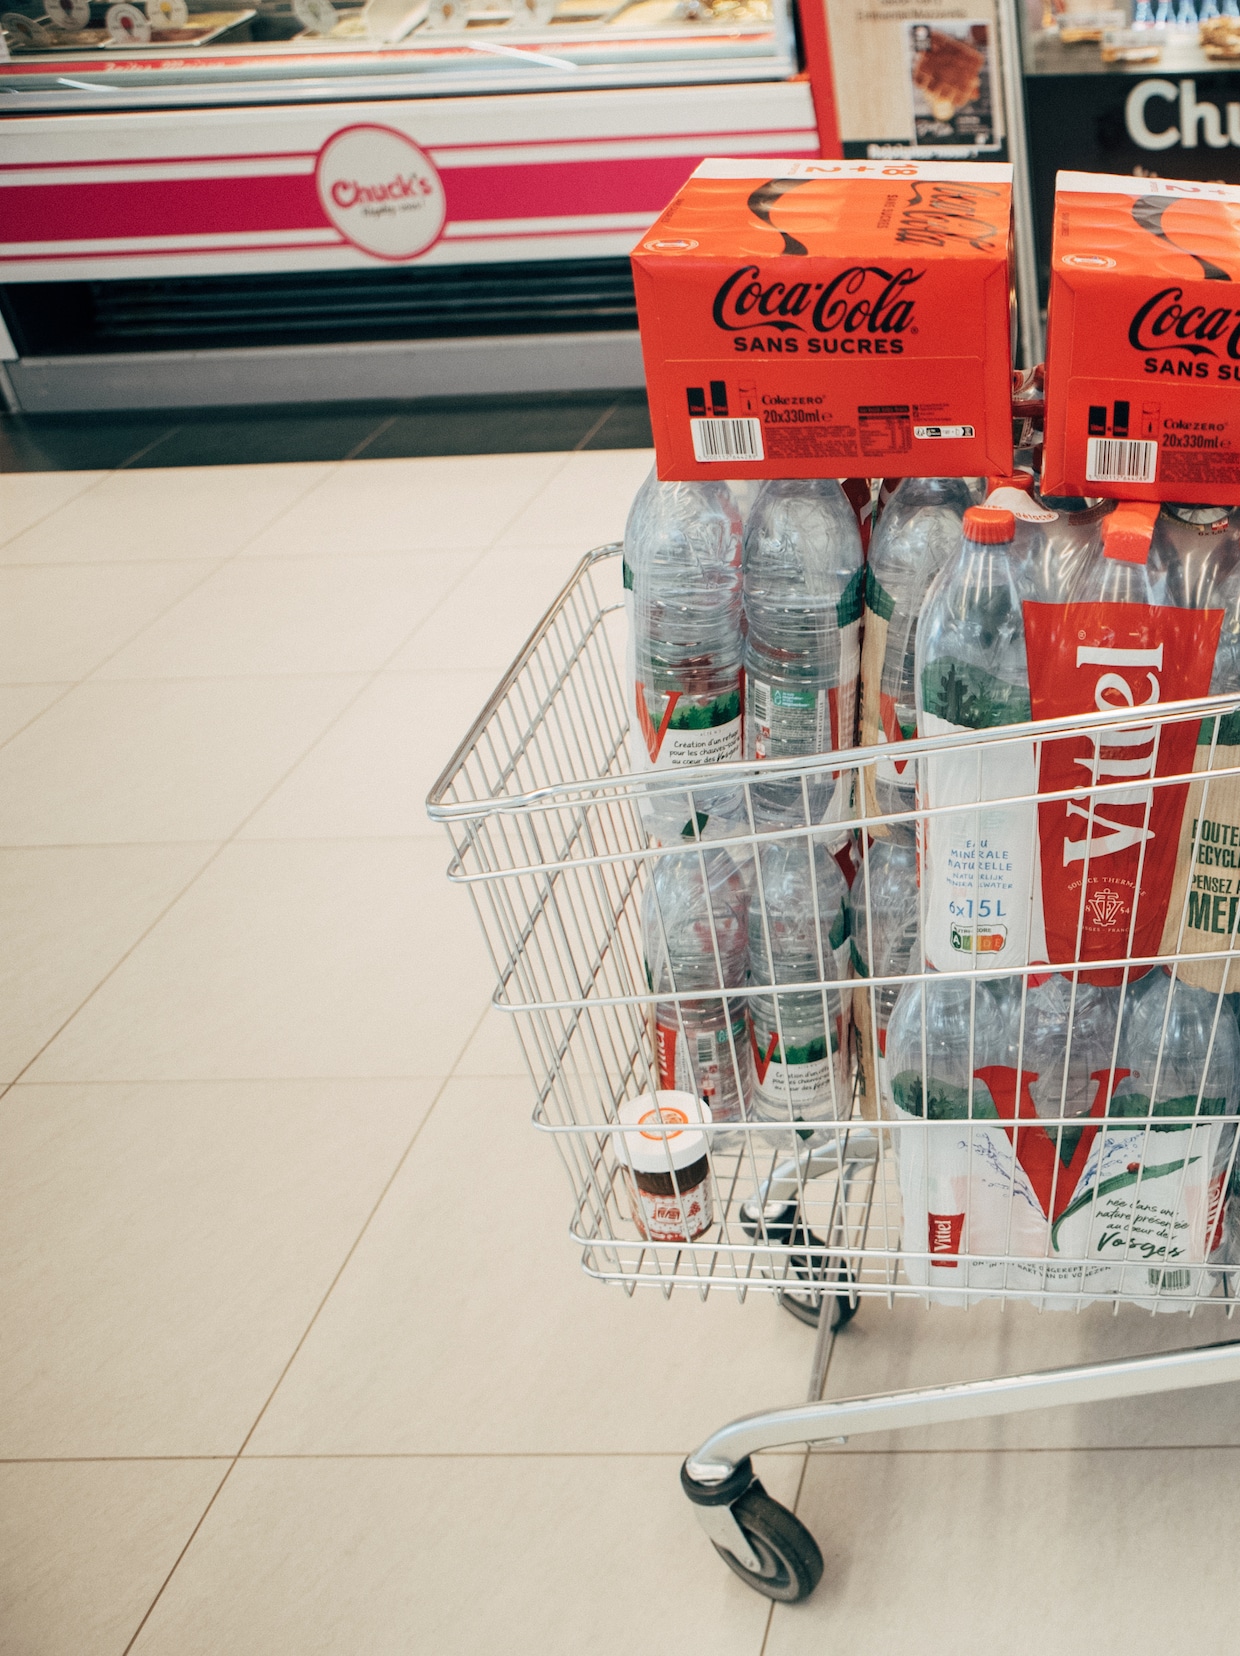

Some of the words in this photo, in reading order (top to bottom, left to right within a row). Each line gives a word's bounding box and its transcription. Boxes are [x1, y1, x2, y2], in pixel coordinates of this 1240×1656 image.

[330, 173, 432, 208] Chuck's
[712, 265, 927, 333] Coca-Cola
[733, 336, 799, 353] SANS
[807, 337, 904, 355] SUCRES
[1144, 356, 1209, 379] SANS
[763, 408, 820, 424] 20x330ml
[1162, 433, 1220, 450] 20x330ml
[674, 740, 706, 748] Création
[708, 736, 721, 747] d'un
[669, 749, 685, 758] pour
[688, 749, 698, 757] les
[704, 755, 716, 763] des
[1062, 642, 1164, 868] Vittel
[953, 872, 1004, 881] NATURLIJK
[1067, 877, 1099, 892] SOUCE
[1106, 1198, 1127, 1207] née
[1096, 1206, 1131, 1219] nature
[934, 1220, 952, 1252] Vittel
[1097, 1231, 1187, 1259] Vosges
